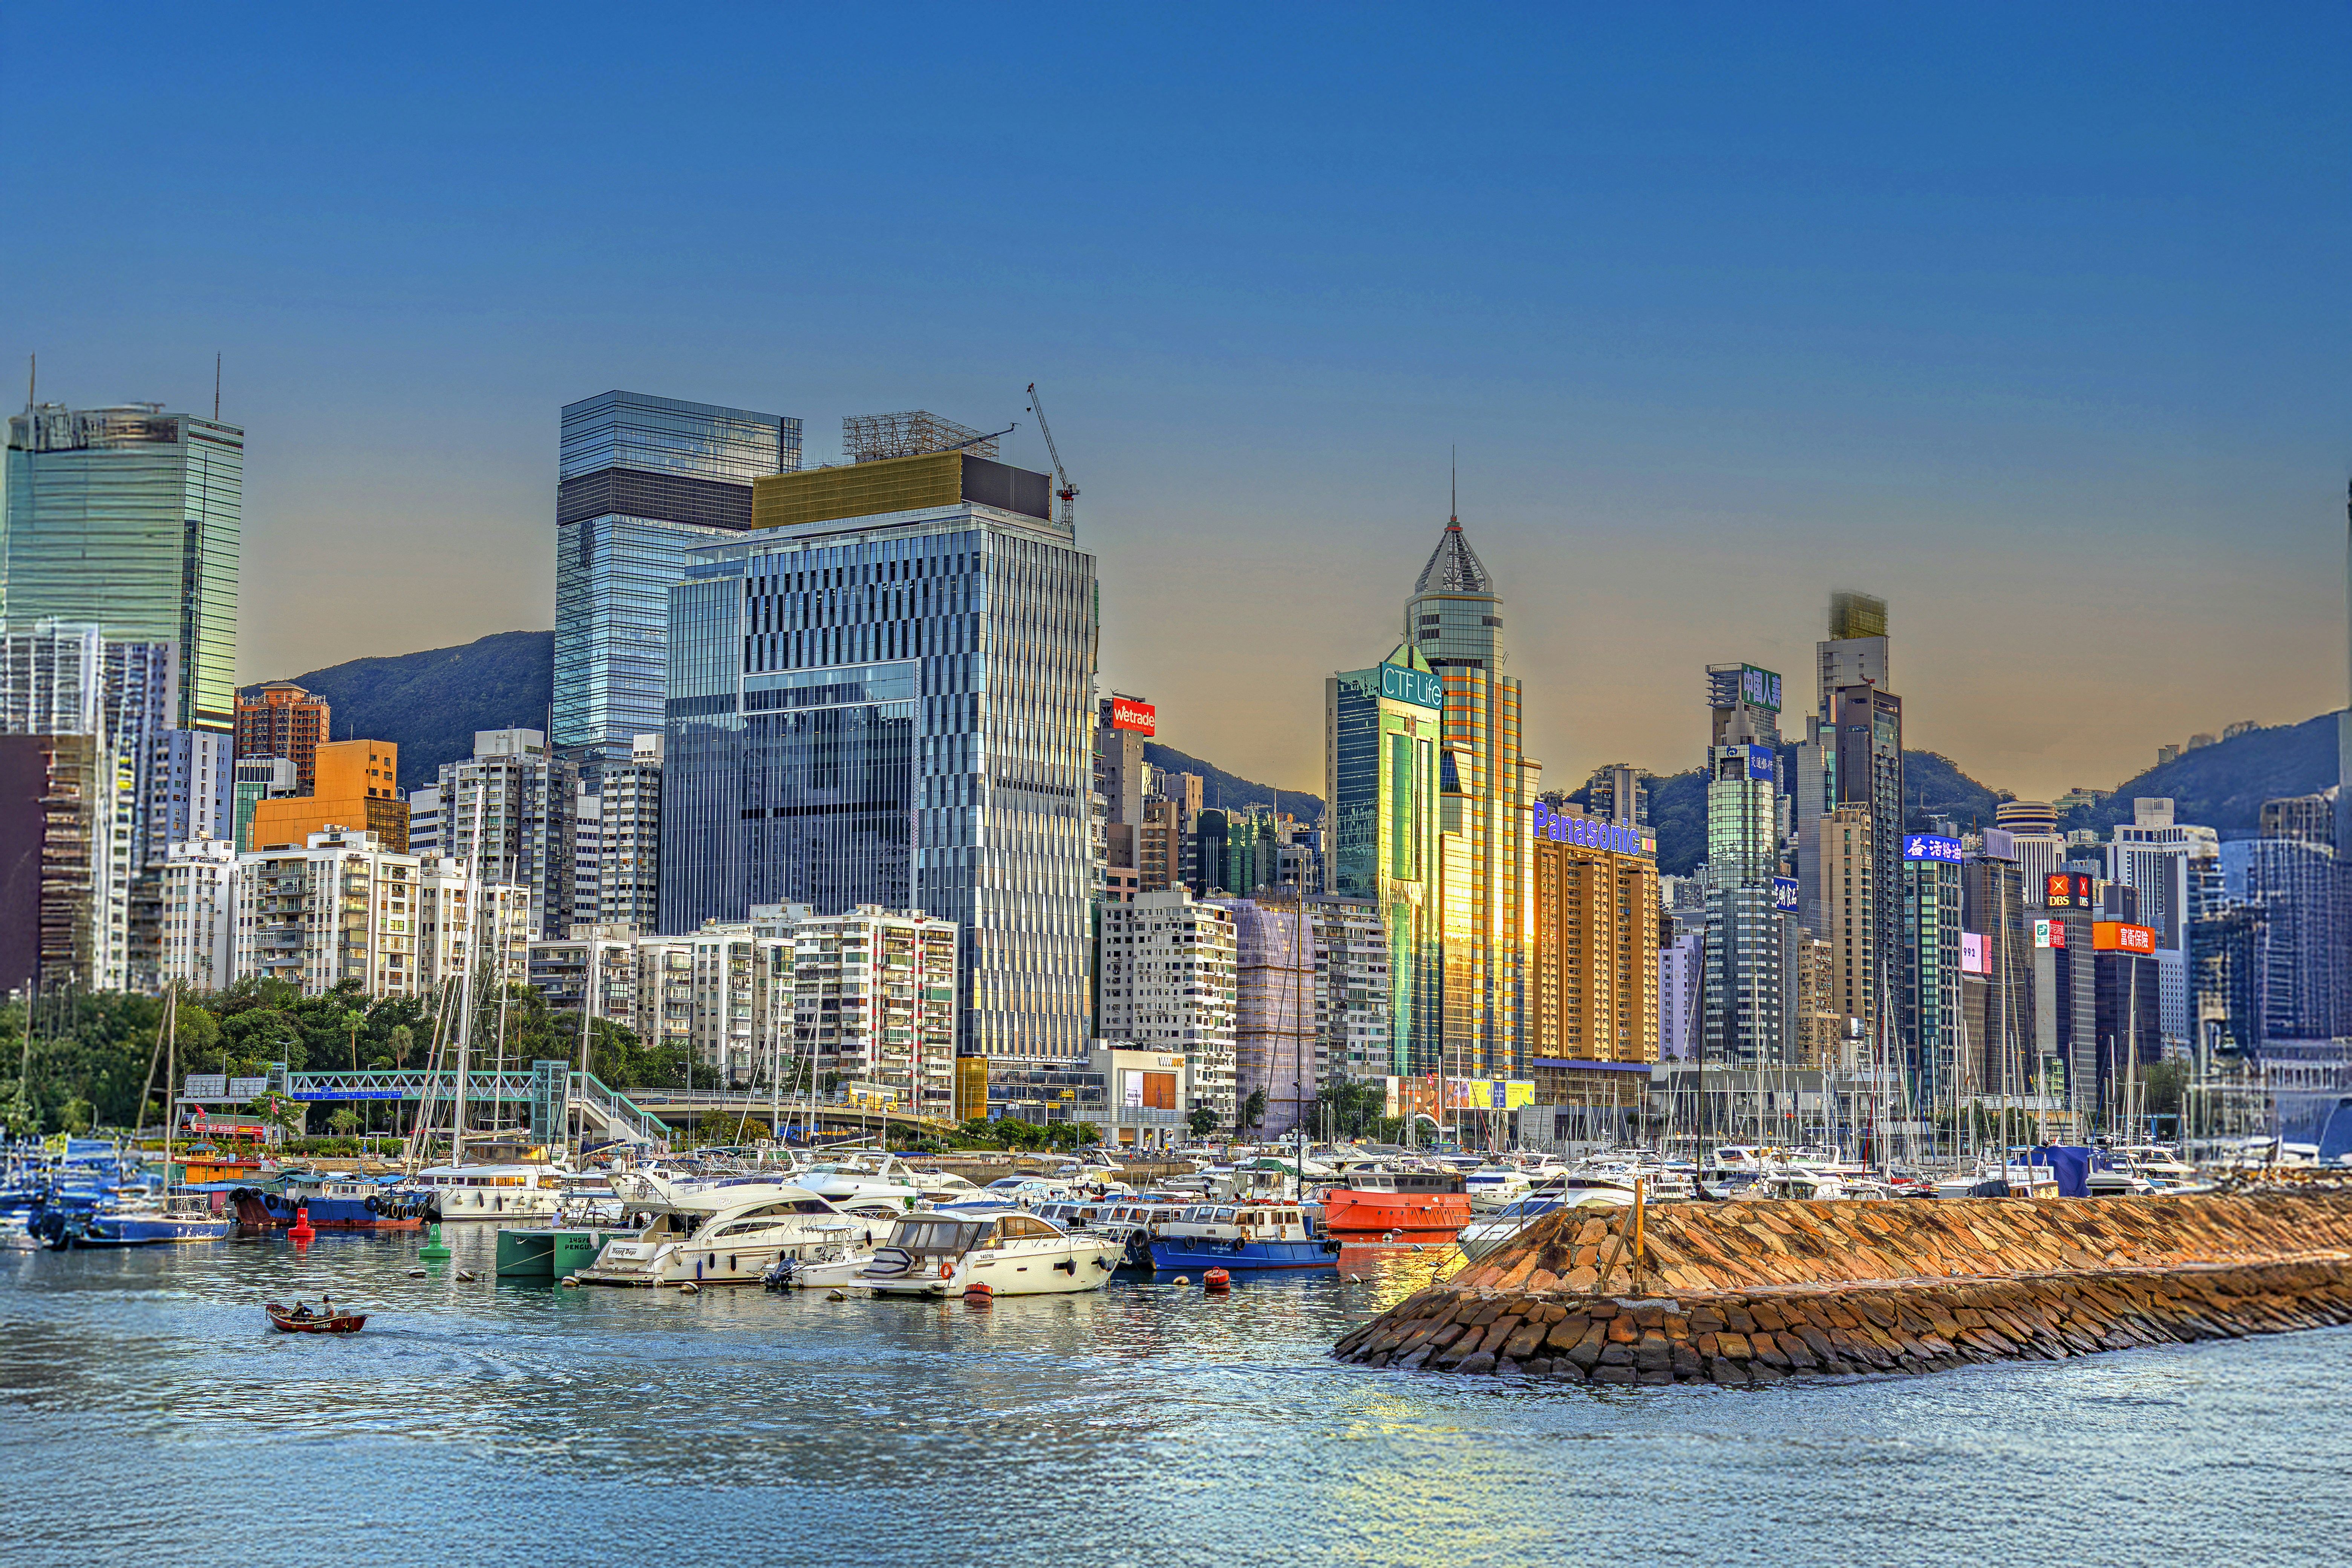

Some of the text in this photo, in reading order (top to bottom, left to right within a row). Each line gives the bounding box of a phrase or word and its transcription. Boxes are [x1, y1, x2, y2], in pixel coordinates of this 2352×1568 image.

[1383, 667, 1442, 706] CTF Life
[1744, 666, 1781, 709] 中国人寿
[1534, 801, 1640, 856] Panasonic
[2049, 896, 2070, 906] DBS
[2079, 896, 2089, 907] DBS
[2120, 927, 2148, 948] 富衛保險
